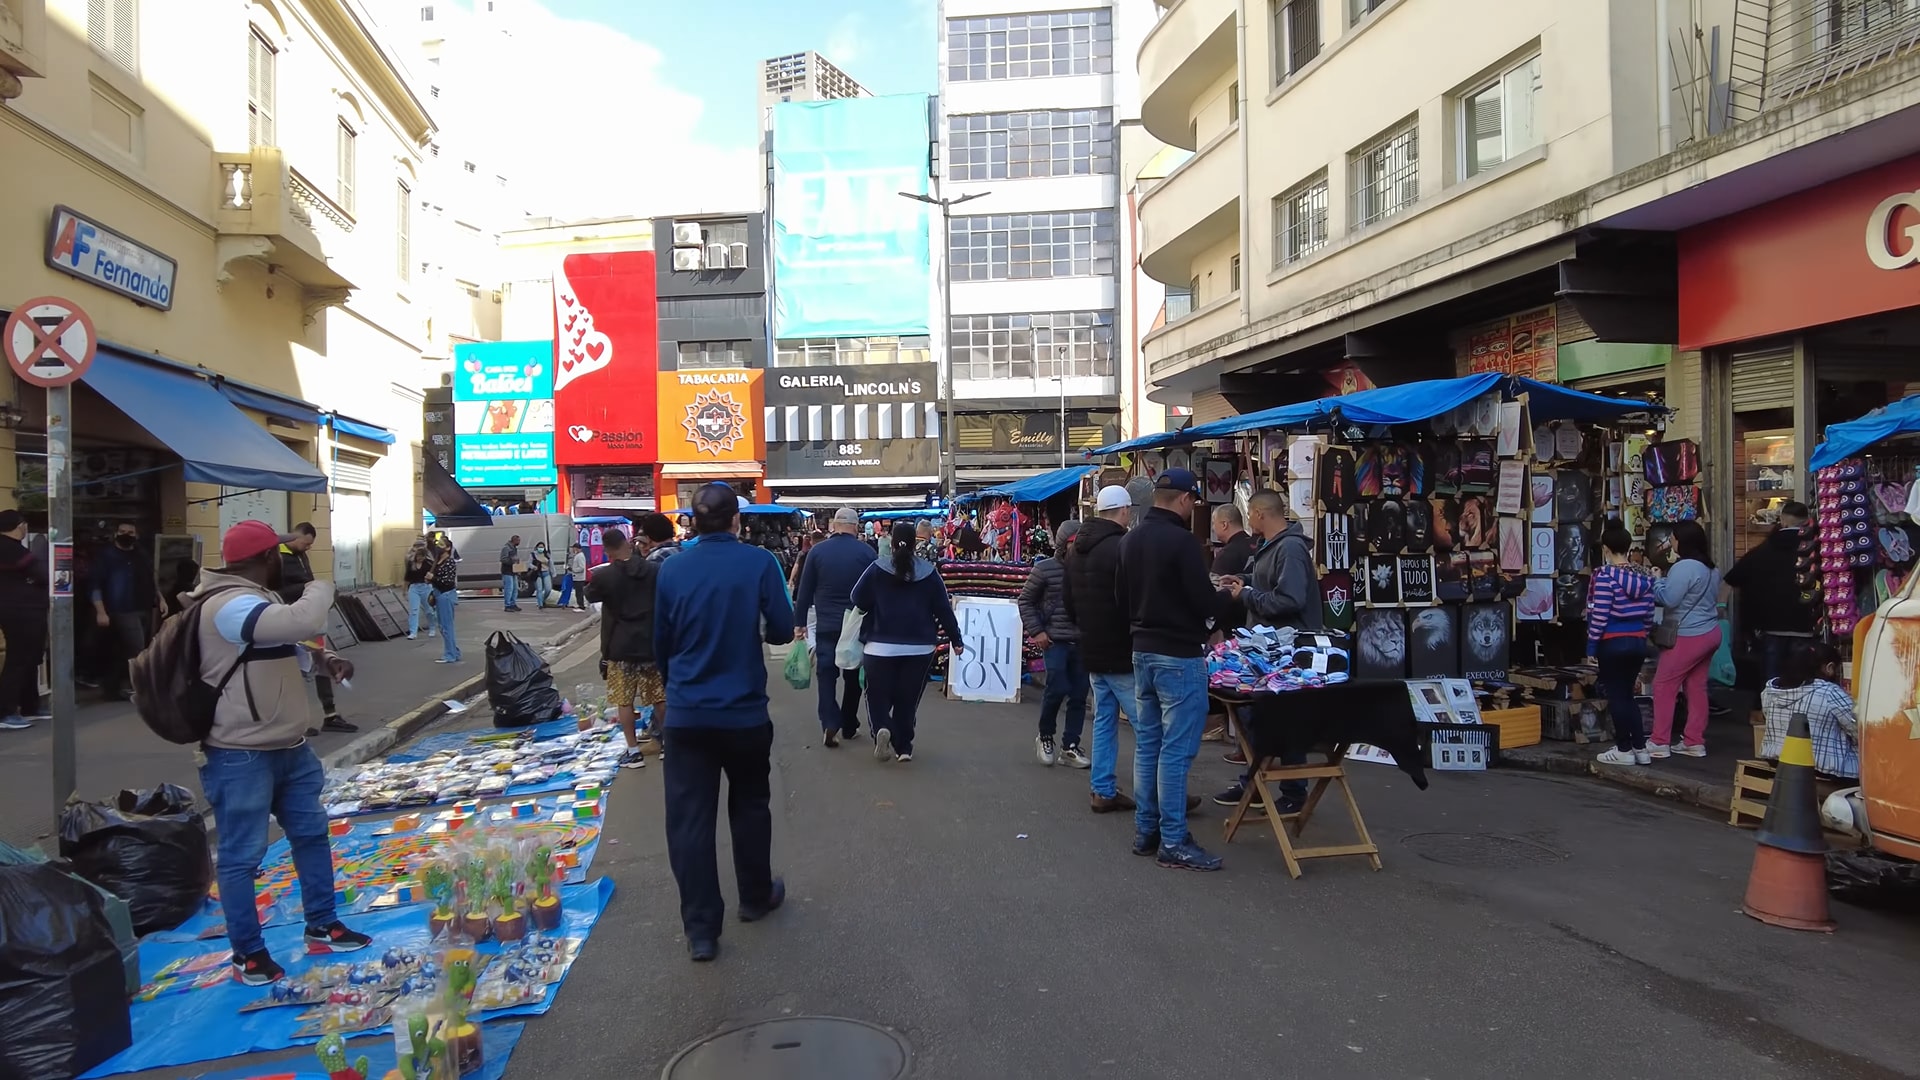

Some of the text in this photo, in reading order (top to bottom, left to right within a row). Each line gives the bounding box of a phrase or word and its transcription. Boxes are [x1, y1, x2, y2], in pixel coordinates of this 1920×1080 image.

[94, 249, 169, 303] Fernando
[677, 373, 749, 384] TABACARIA
[780, 375, 921, 396] GALERIA LINCOLN'S
[591, 430, 643, 442] Passion
[1009, 430, 1055, 446] Emilly
[839, 444, 863, 455] 885
[1401, 559, 1429, 569] DEPOIS DE
[1403, 570, 1428, 584] TUDO
[962, 661, 1007, 691] ON
[1465, 669, 1505, 680] EXECUÇÃO
